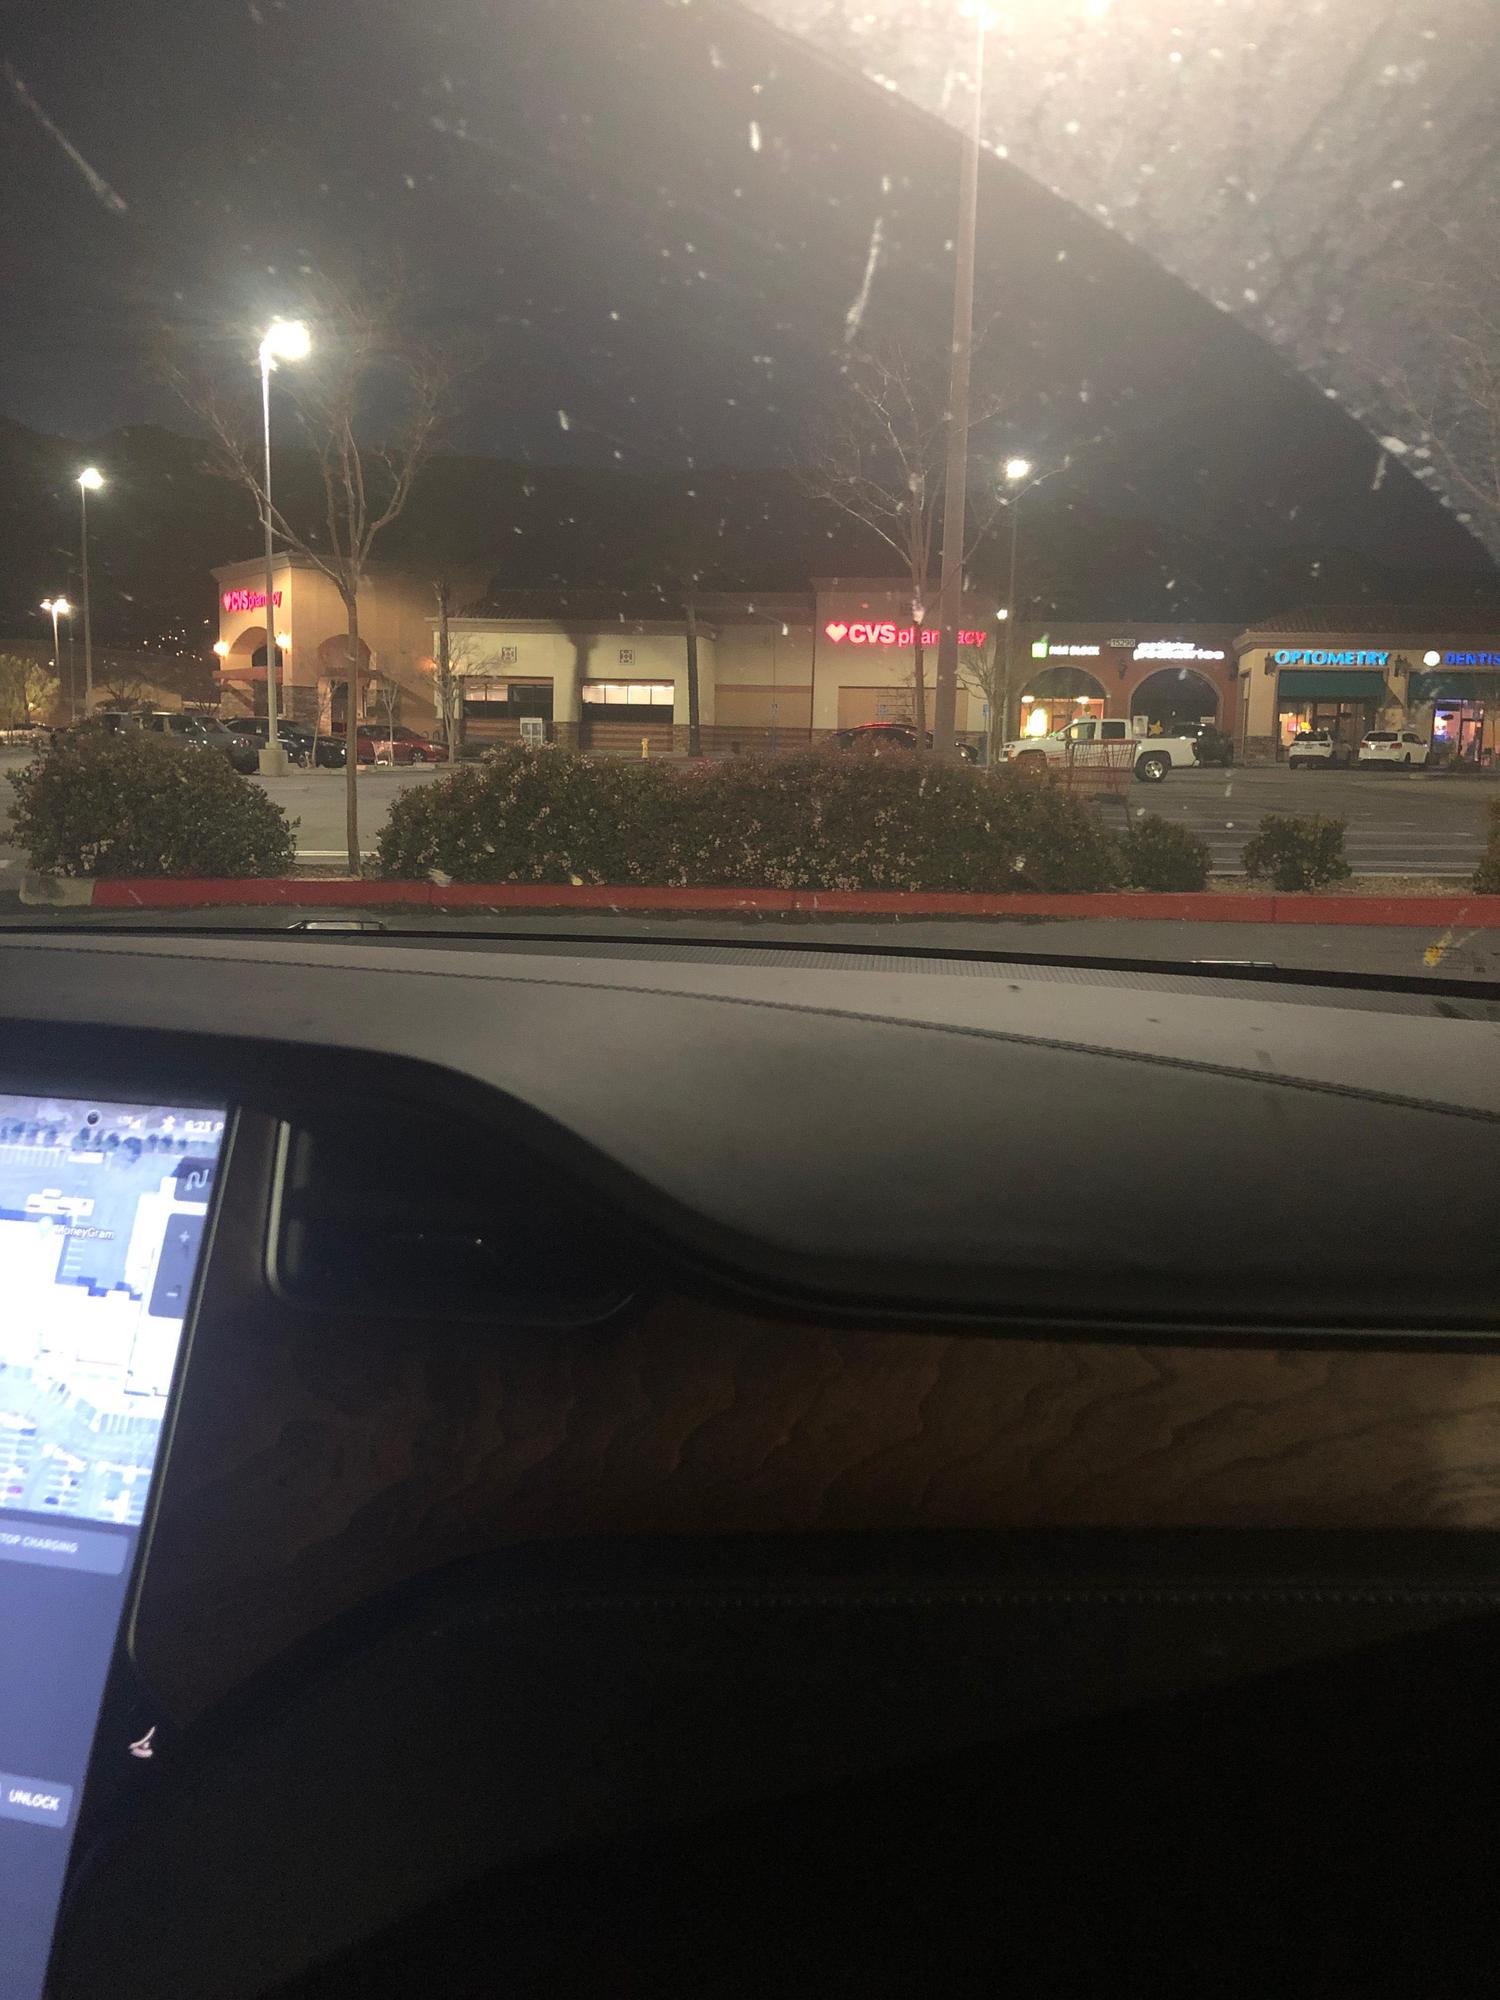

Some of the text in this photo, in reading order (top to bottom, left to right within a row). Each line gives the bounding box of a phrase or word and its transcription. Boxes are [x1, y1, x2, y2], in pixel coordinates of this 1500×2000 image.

[231, 590, 248, 611] CVS
[849, 624, 896, 644] CVS
[1274, 650, 1389, 665] OPTOMETRY
[54, 1224, 114, 1240] MoneyGram
[9, 1789, 60, 1811] UNLOCK
